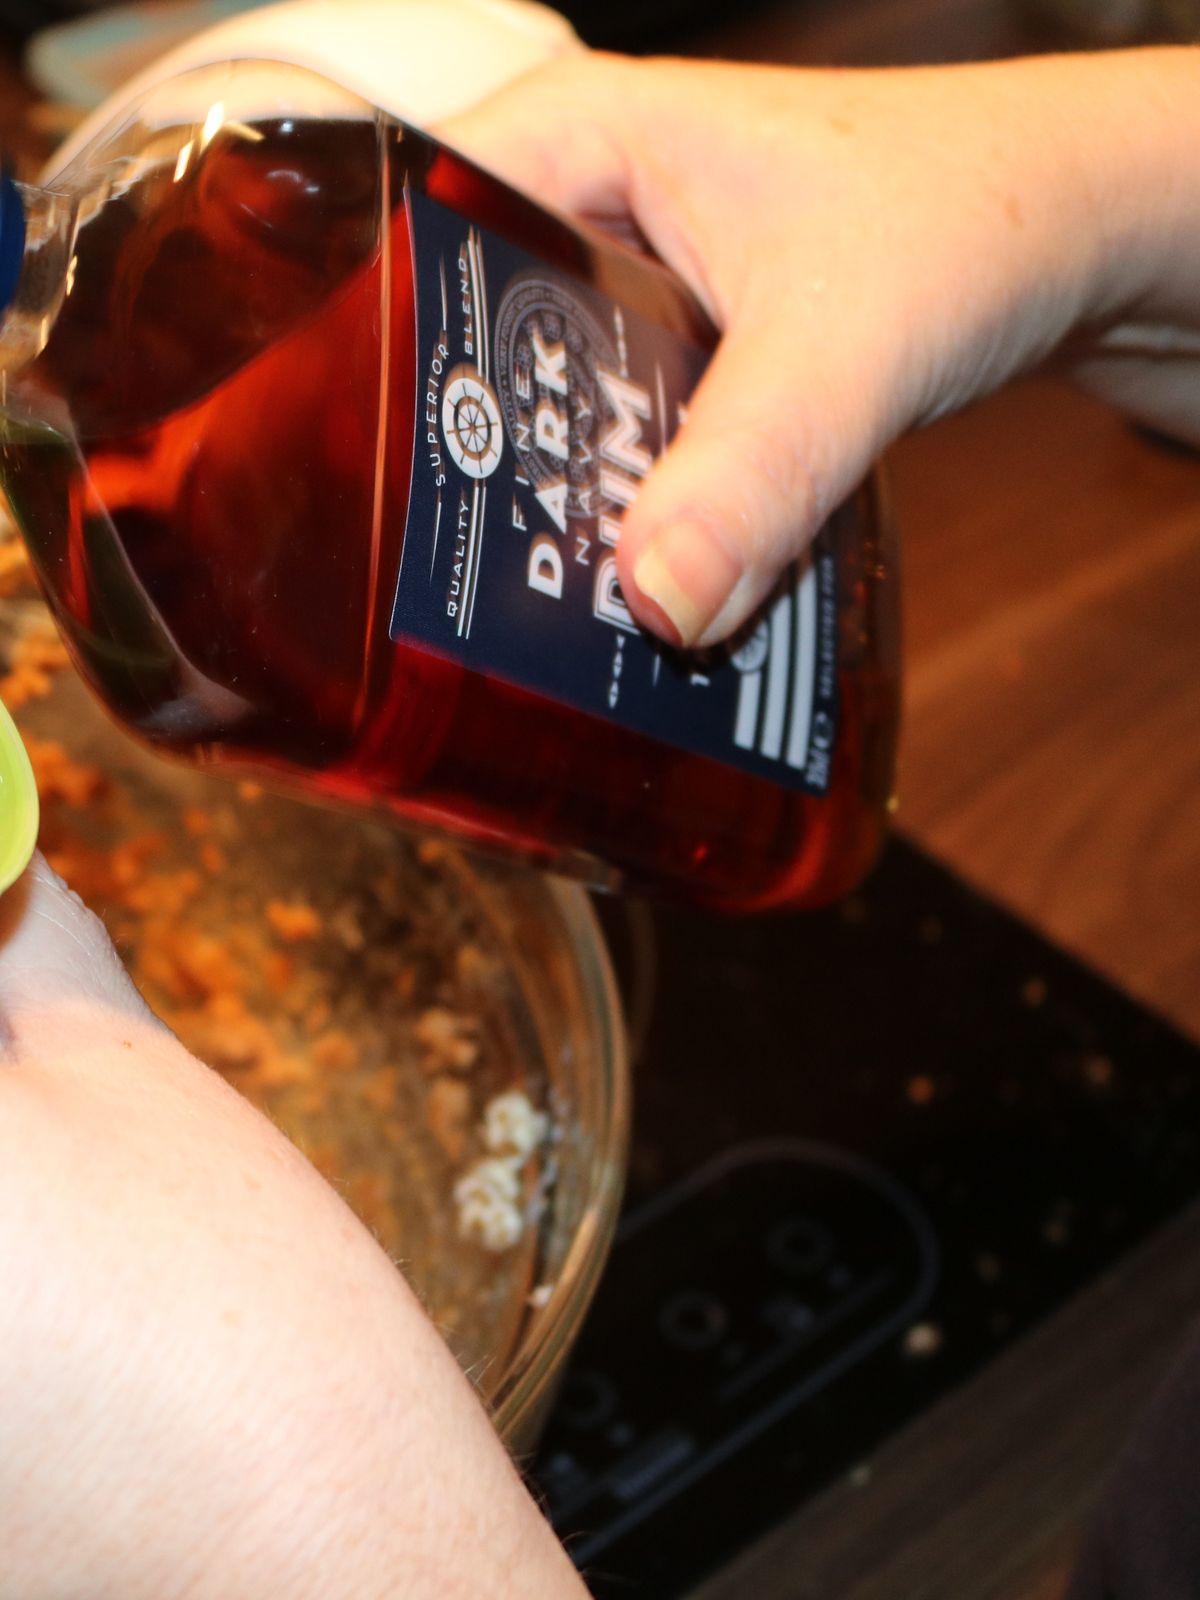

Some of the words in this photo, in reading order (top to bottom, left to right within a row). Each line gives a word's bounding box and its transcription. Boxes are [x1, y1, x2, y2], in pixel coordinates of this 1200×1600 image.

[426, 344, 449, 487] SUPERIOR
[447, 500, 469, 617] QUALITY
[458, 257, 473, 355] BLEND
[512, 369, 531, 531] FINE
[528, 327, 568, 600] DARK
[575, 395, 592, 566] NAVY
